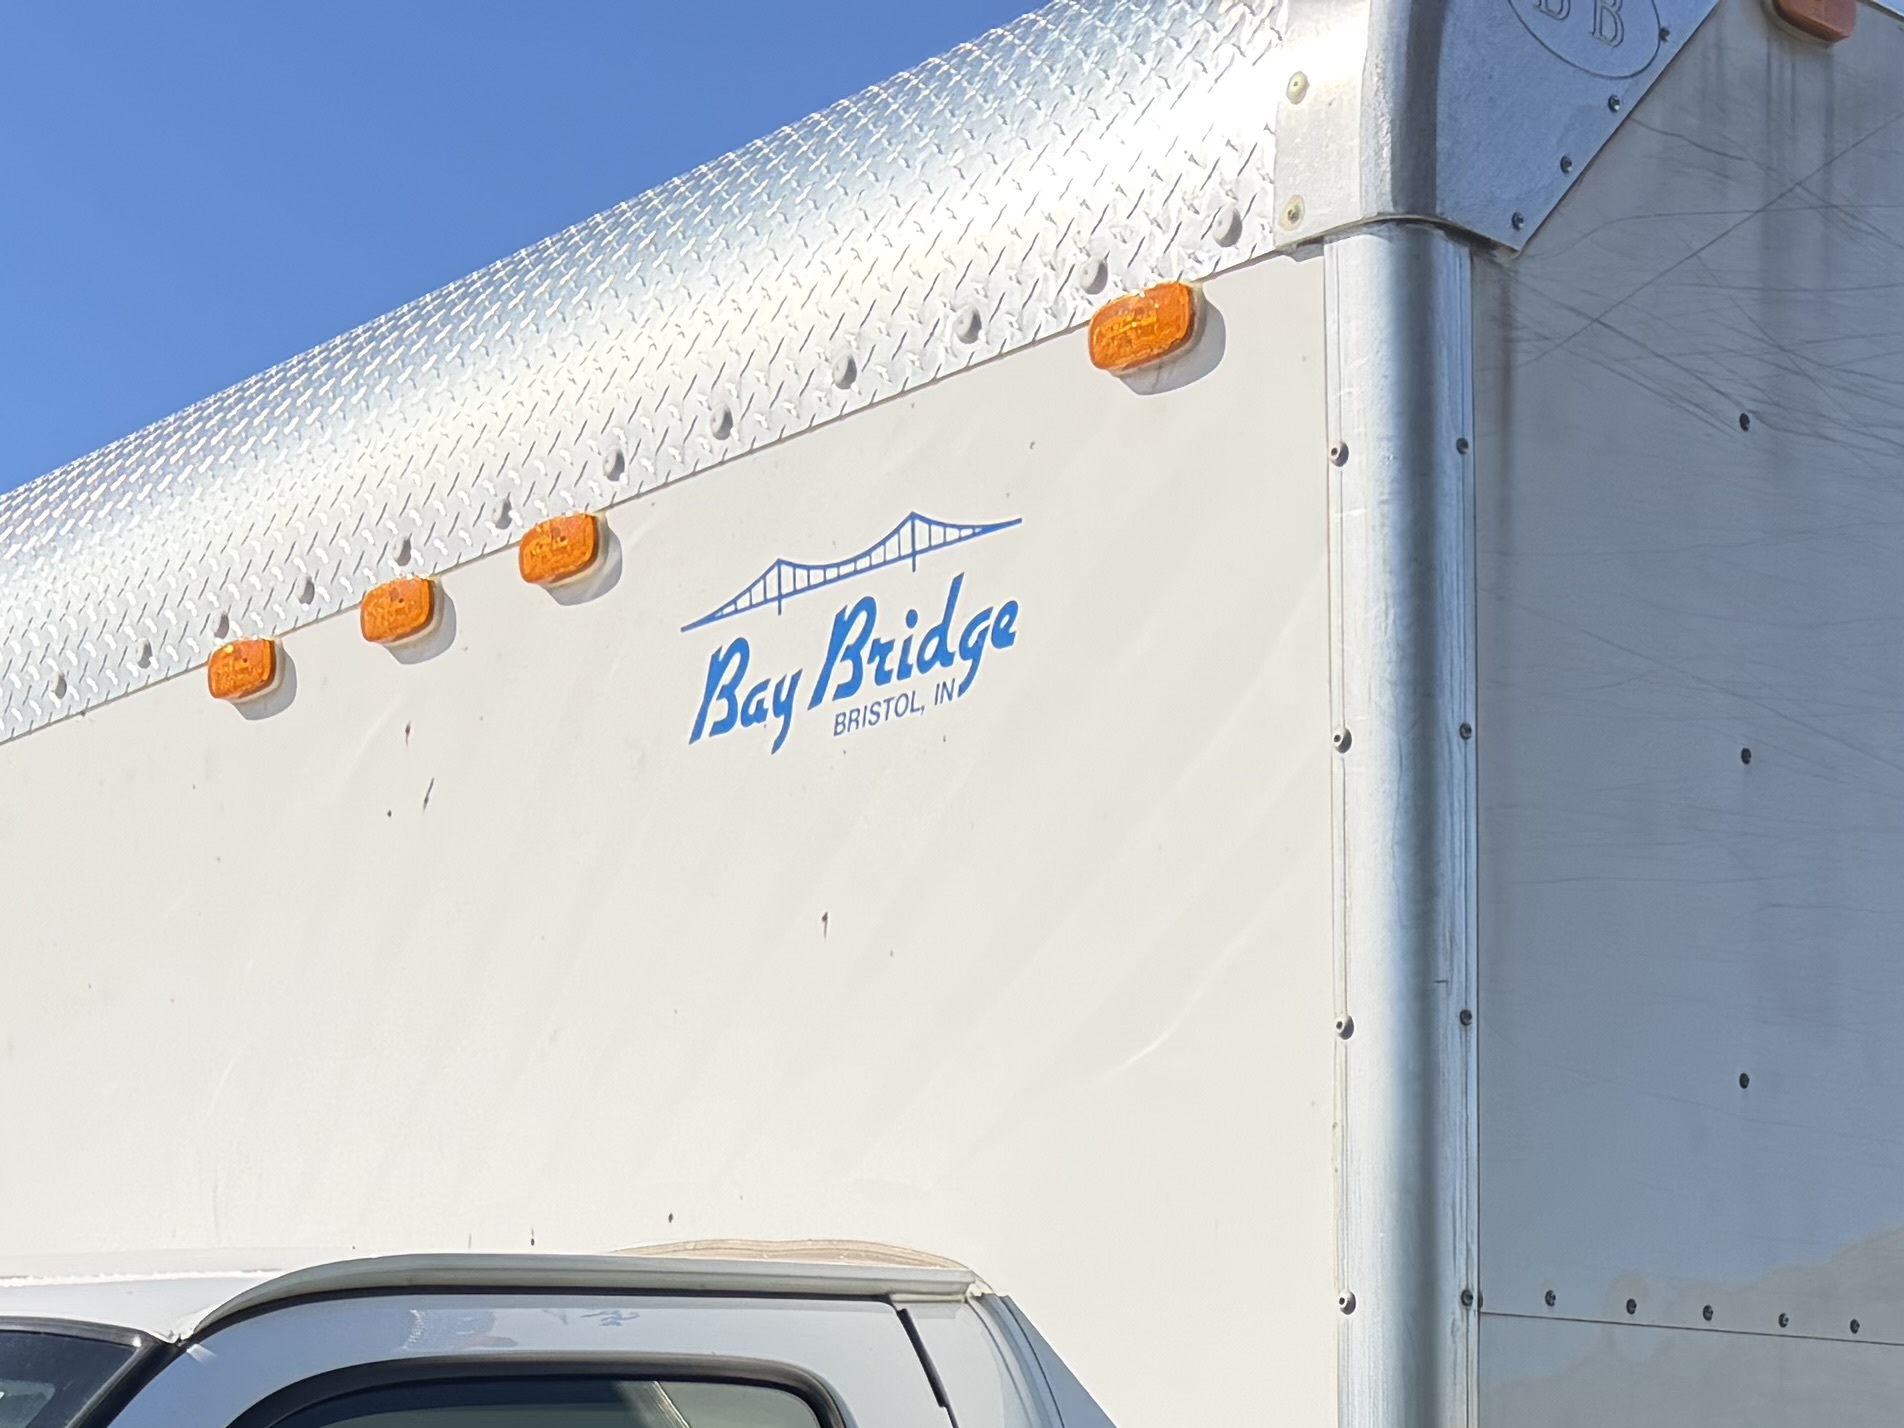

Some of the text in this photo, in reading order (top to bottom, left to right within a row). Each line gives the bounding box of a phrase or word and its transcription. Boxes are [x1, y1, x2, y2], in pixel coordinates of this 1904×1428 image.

[688, 571, 1020, 755] Bay Bridge
[833, 677, 957, 737] BRISTOL, IN
